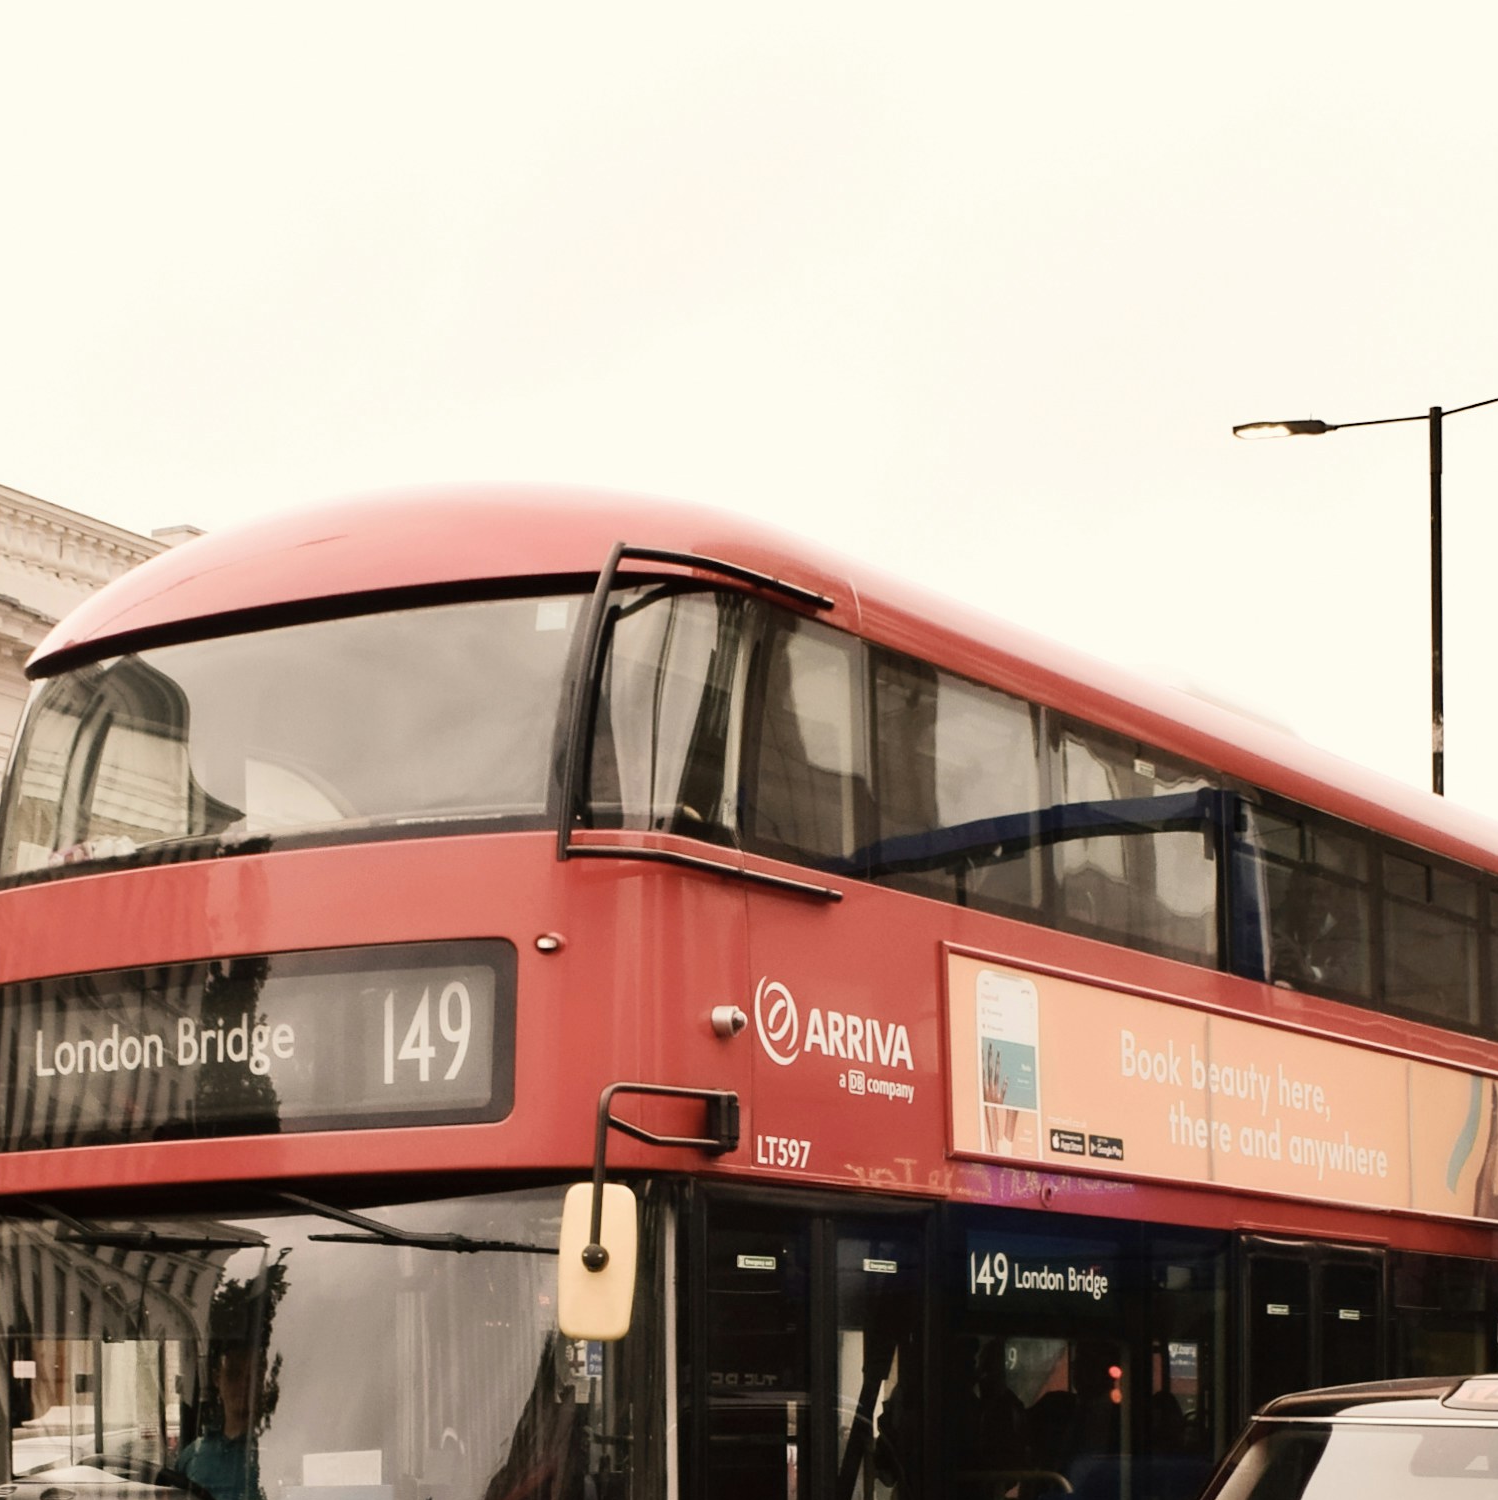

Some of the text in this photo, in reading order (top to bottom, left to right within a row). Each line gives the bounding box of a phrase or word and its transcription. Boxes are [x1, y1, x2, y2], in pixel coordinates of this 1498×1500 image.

[36, 980, 472, 1085] London Bridge 149
[804, 1008, 914, 1071] ARRIVA
[839, 1071, 914, 1104] a DB company
[1120, 1029, 1331, 1122] Book beauty here,
[757, 1135, 812, 1168] LT597
[1169, 1100, 1388, 1180] there and anywhere
[971, 1251, 1108, 1300] 149 London Bridge
